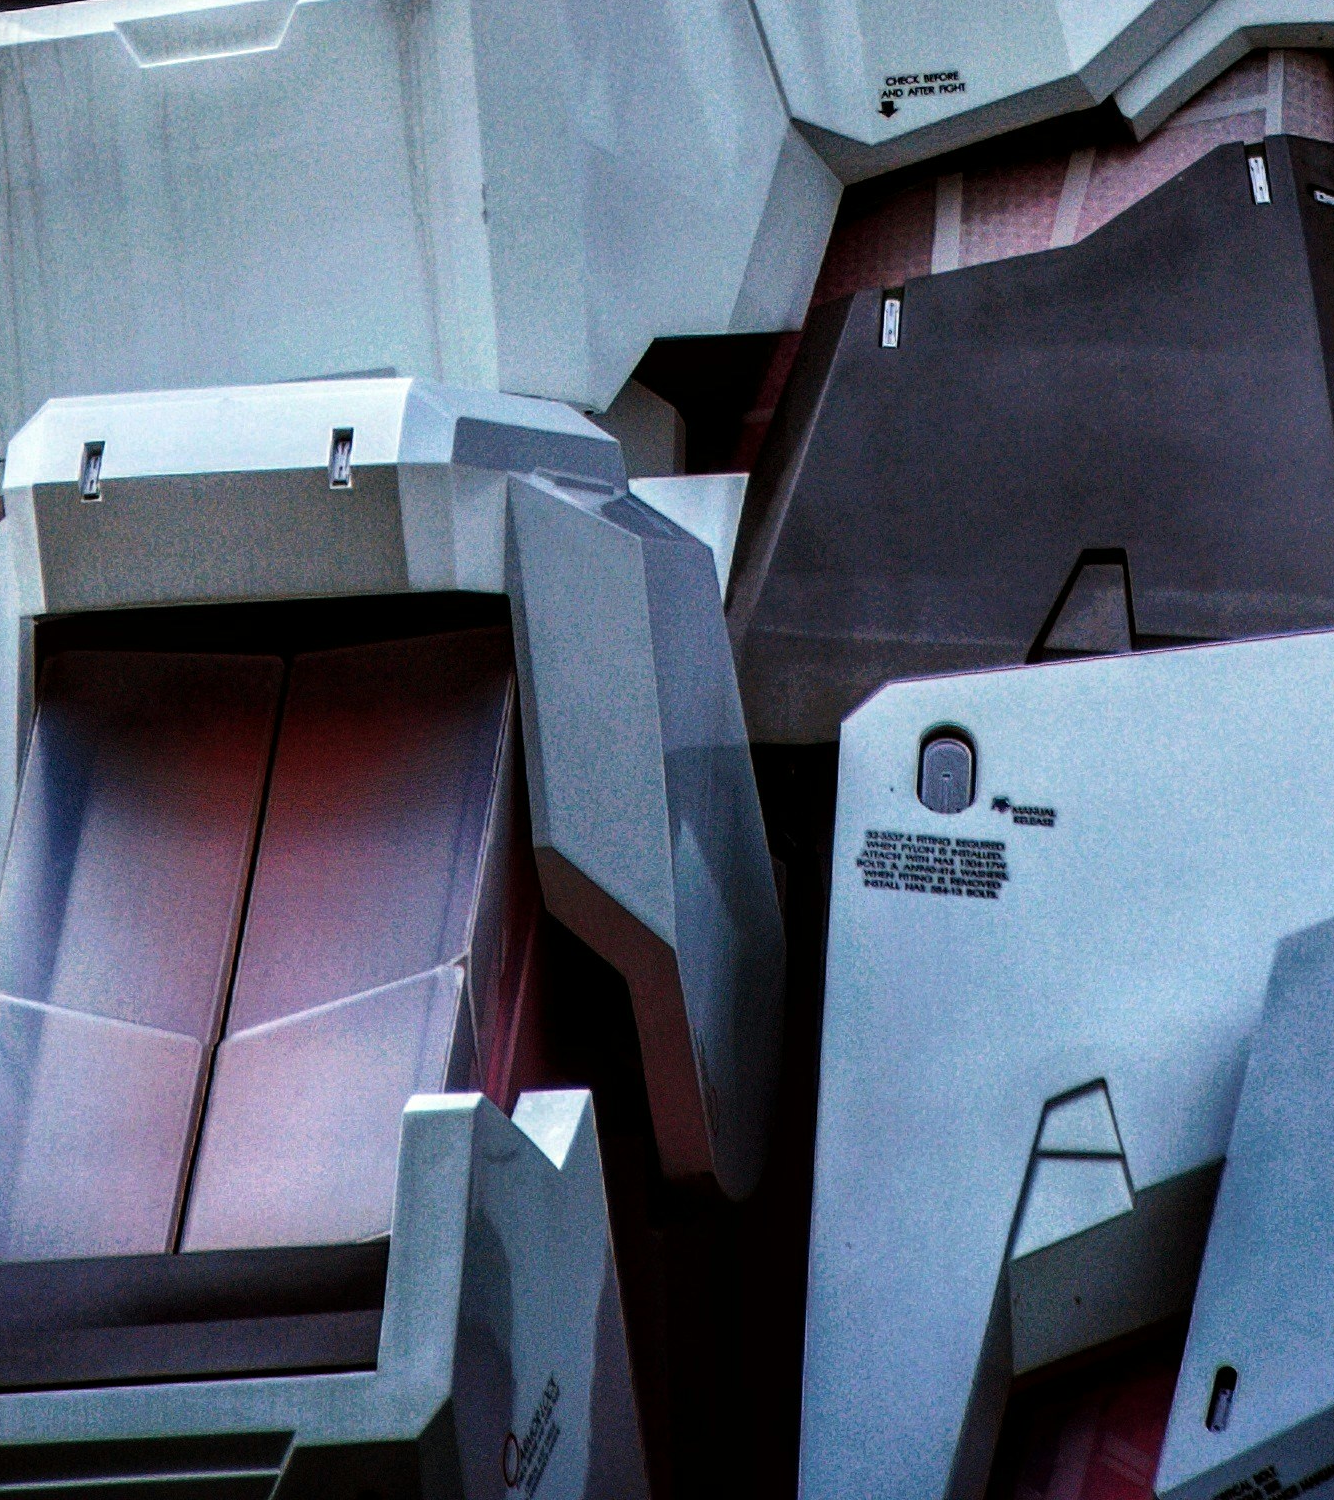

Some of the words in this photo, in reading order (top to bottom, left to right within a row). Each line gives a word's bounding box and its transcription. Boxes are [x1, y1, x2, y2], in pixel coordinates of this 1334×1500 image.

[886, 74, 919, 86] CHECK
[924, 71, 958, 83] BEFORE
[881, 89, 903, 99] AND
[908, 86, 935, 96] AFTER
